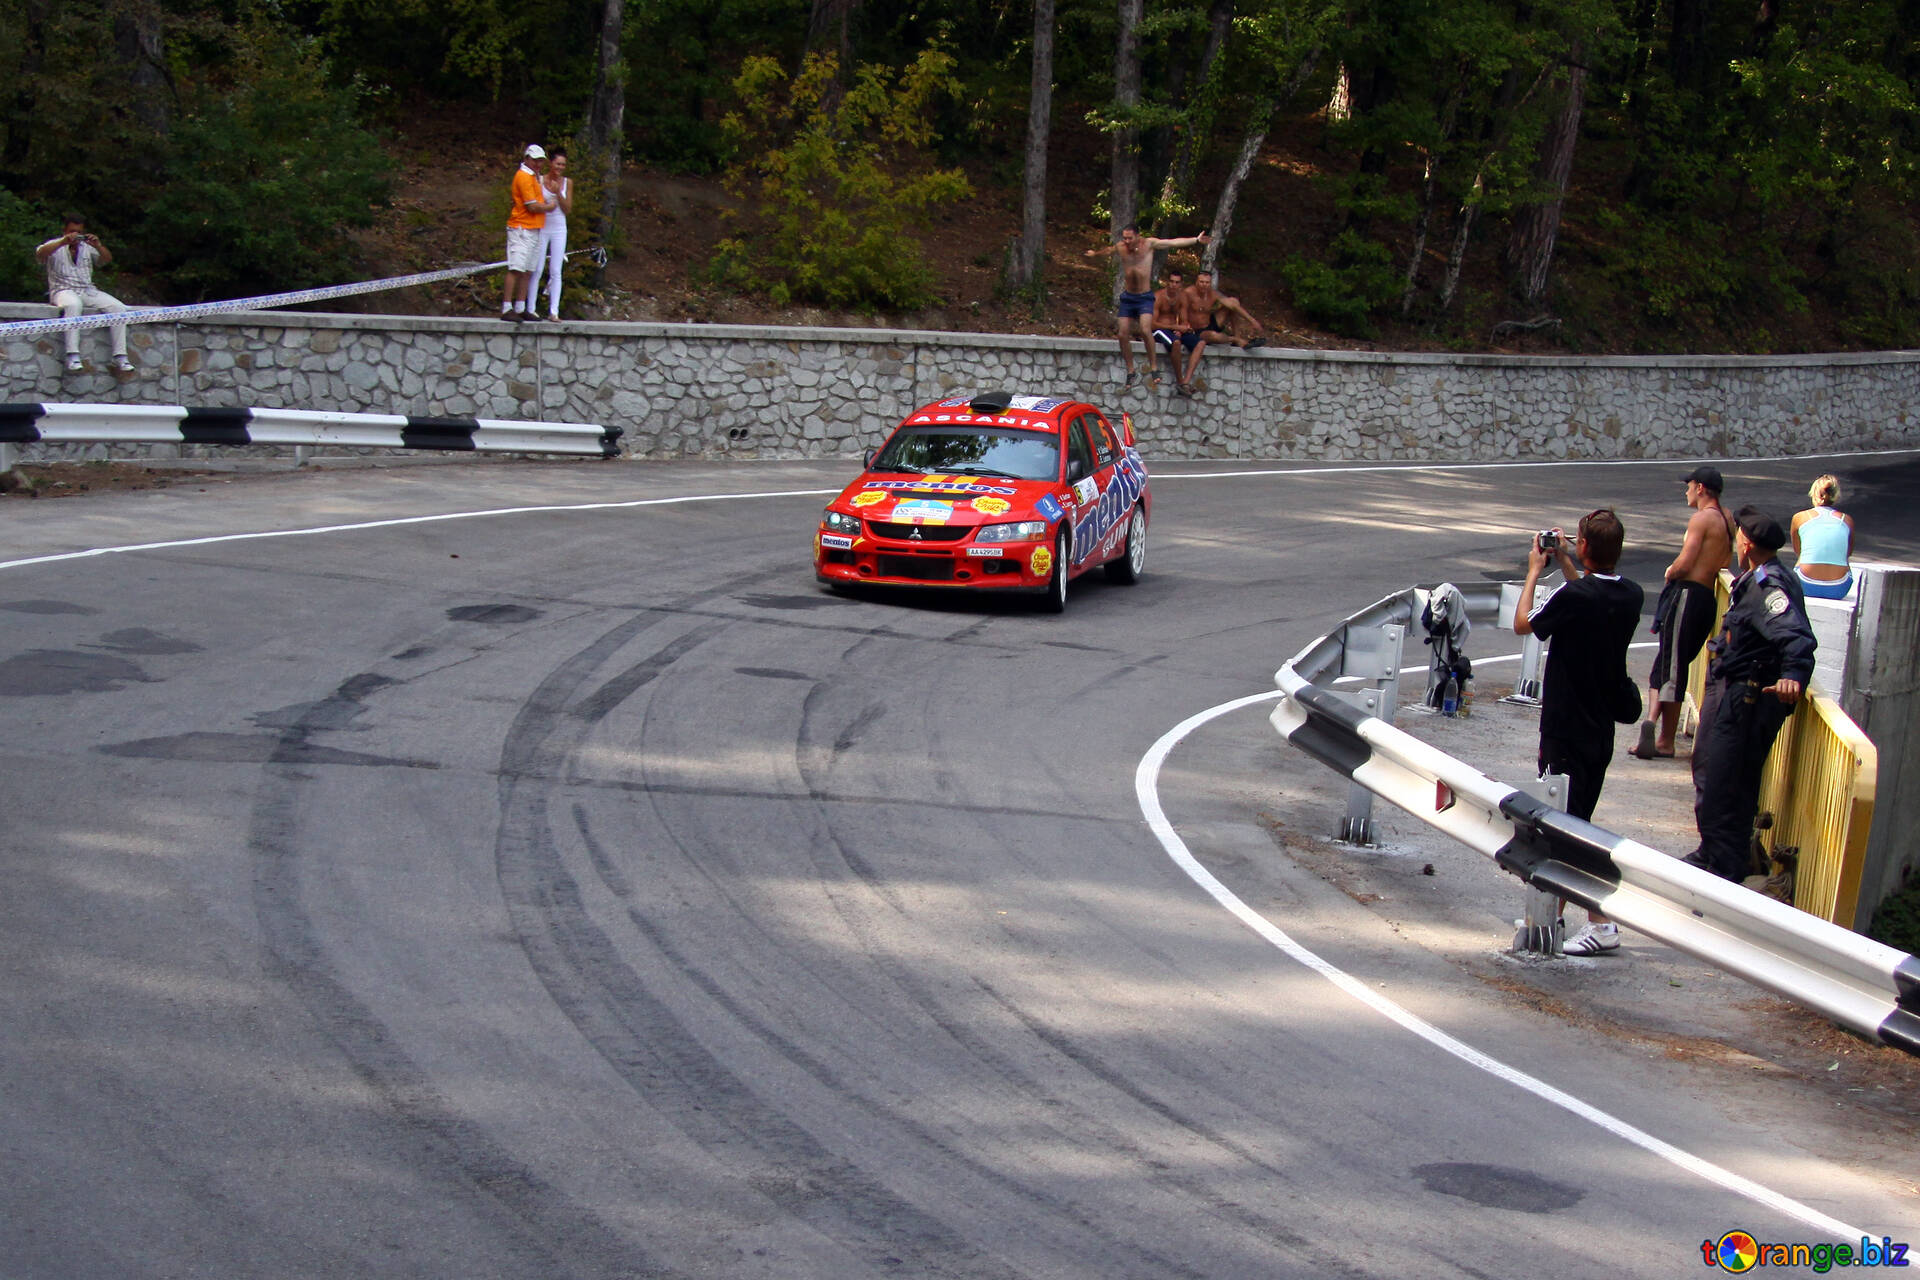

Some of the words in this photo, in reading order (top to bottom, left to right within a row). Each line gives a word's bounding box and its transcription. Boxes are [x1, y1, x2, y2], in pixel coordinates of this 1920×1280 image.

[914, 415, 1050, 429] ASCANIA
[863, 481, 1017, 495] mentos
[1102, 517, 1129, 558] GUM
